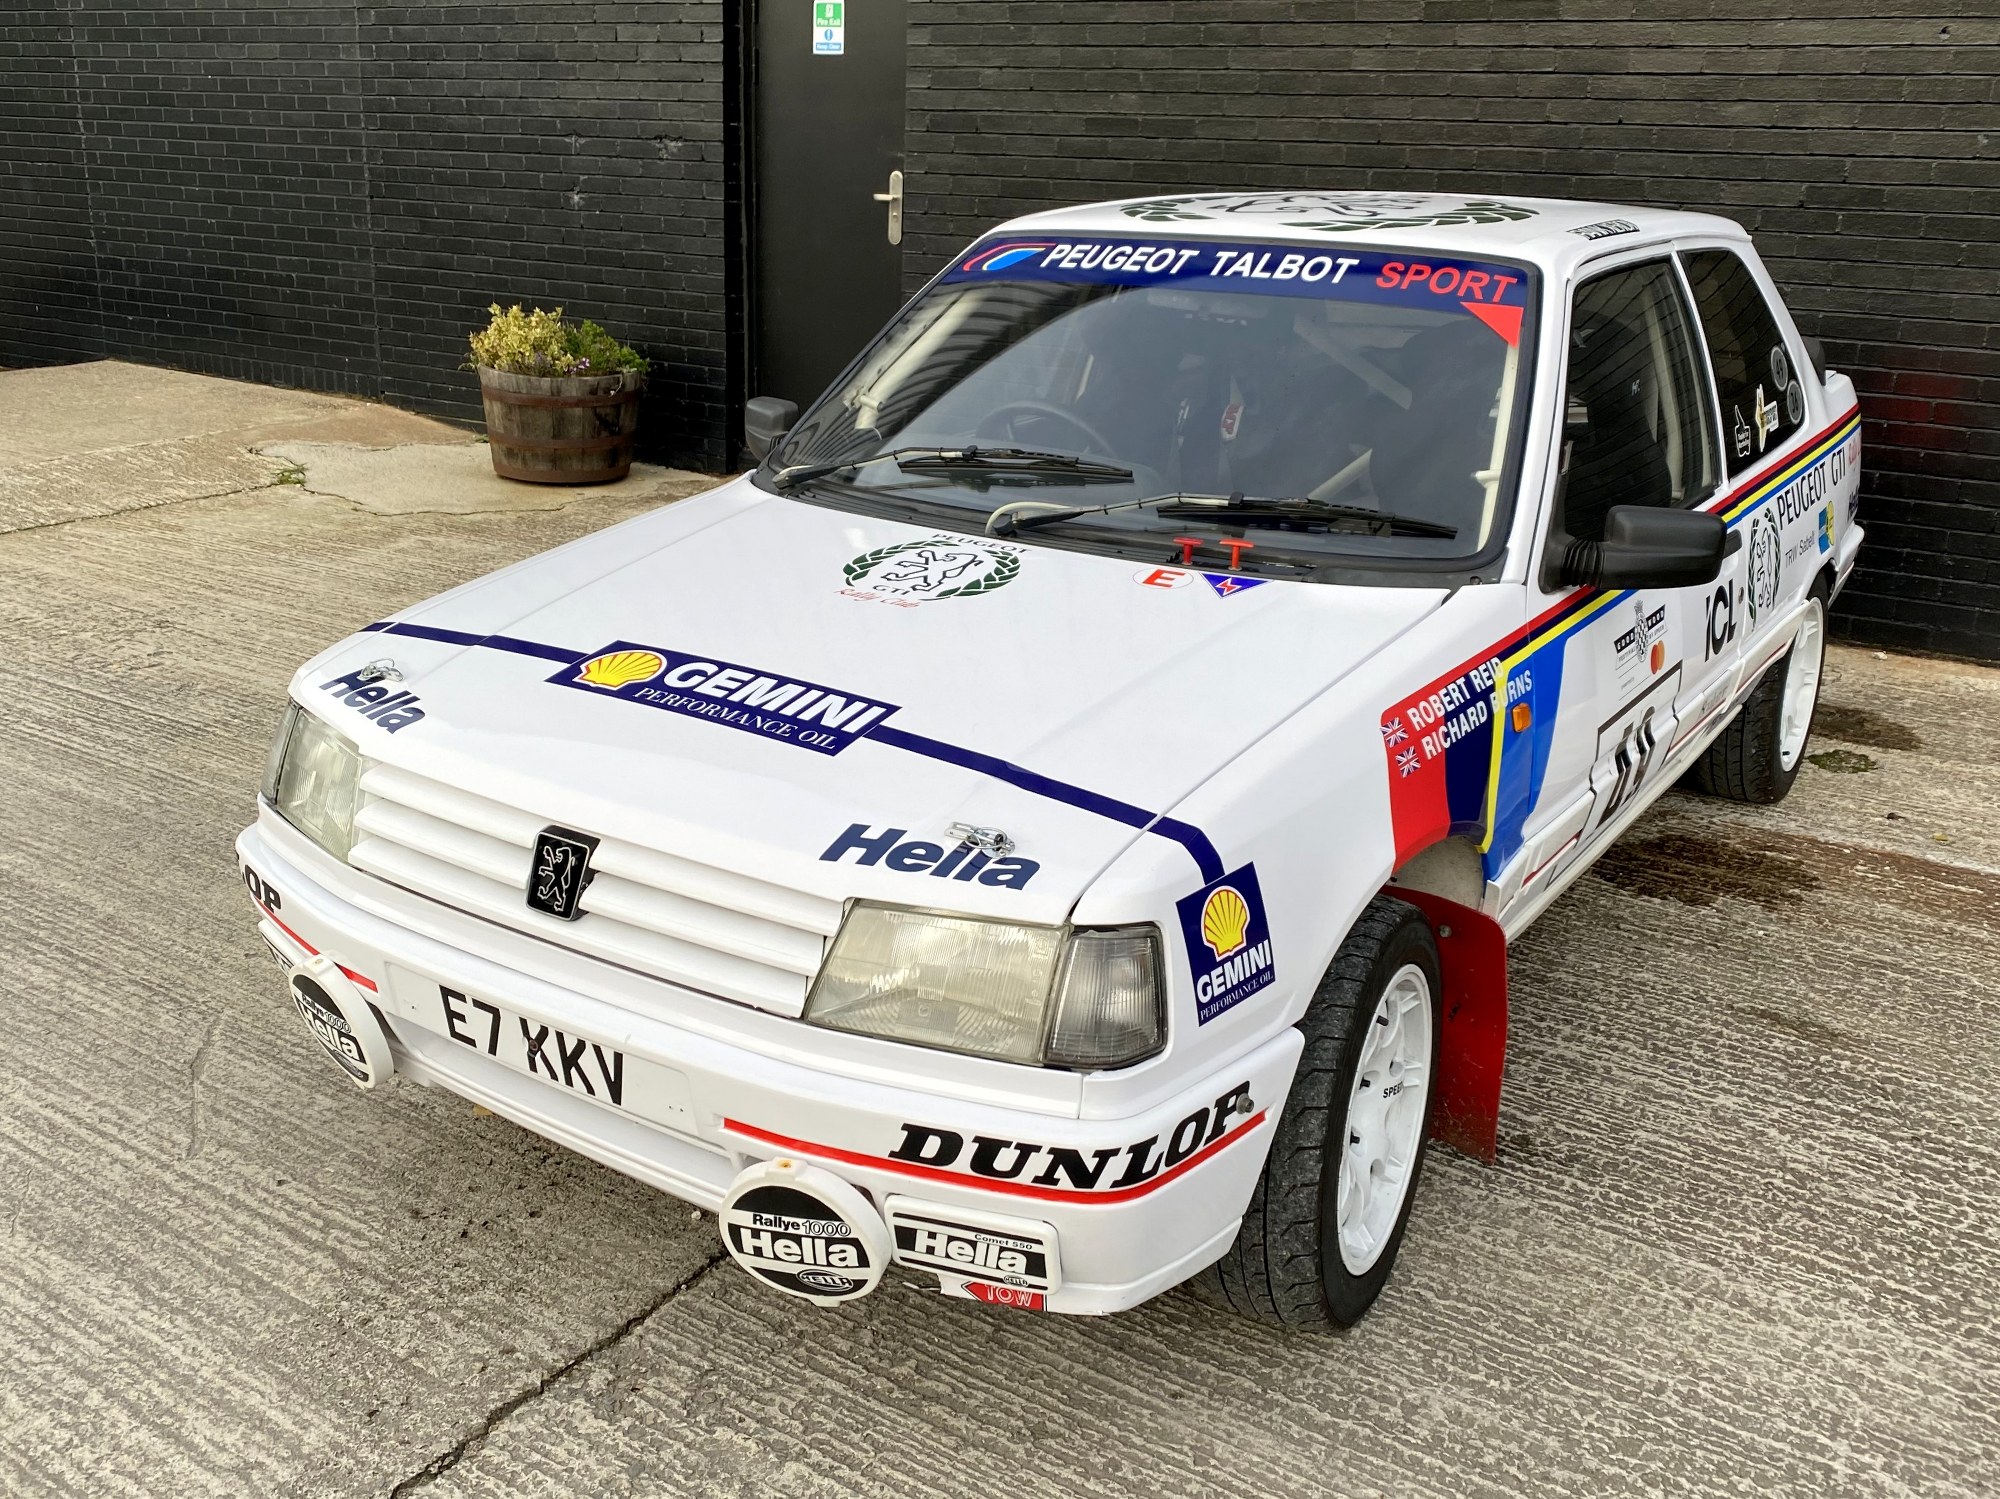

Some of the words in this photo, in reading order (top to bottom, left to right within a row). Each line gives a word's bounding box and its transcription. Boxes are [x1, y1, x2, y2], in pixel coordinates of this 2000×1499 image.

[1039, 243, 1200, 276] PEUGEOT
[1208, 250, 1360, 285] TALBOT
[1375, 261, 1519, 303] SPORT
[1776, 461, 1827, 531] PEUGEOT
[1831, 446, 1846, 487] GTI
[931, 533, 1032, 554] PEUGEOT
[872, 584, 911, 596] GTI
[1142, 568, 1186, 588] E
[1704, 578, 1738, 663] ICL
[318, 668, 426, 735] Hella
[633, 687, 801, 738] PERFORMANCE
[797, 730, 838, 750] OIL
[663, 661, 888, 735] GEMINI
[1406, 676, 1472, 732] ROBERT
[1469, 656, 1505, 693] REID
[1421, 700, 1488, 761] RICHARD
[1489, 669, 1533, 714] BURNS
[818, 822, 1041, 891] Hella
[1196, 938, 1272, 1004] GEMINI
[1200, 978, 1260, 1021] PERFORMANCE
[1259, 970, 1274, 985] OIL
[299, 1001, 361, 1061] Hella
[324, 1011, 352, 1034] 1000
[438, 984, 502, 1057] E7
[518, 1016, 624, 1106] KKV
[888, 1080, 1251, 1190] DUNLOP
[739, 1227, 860, 1268] Hella
[752, 1213, 801, 1232] Rallye
[801, 1219, 852, 1237] 1000
[914, 1229, 1028, 1275] Hella
[974, 1233, 1010, 1246] Comet
[1011, 1241, 1033, 1251] 550
[800, 1273, 853, 1289] HELLA
[984, 1283, 1034, 1307] TOW
